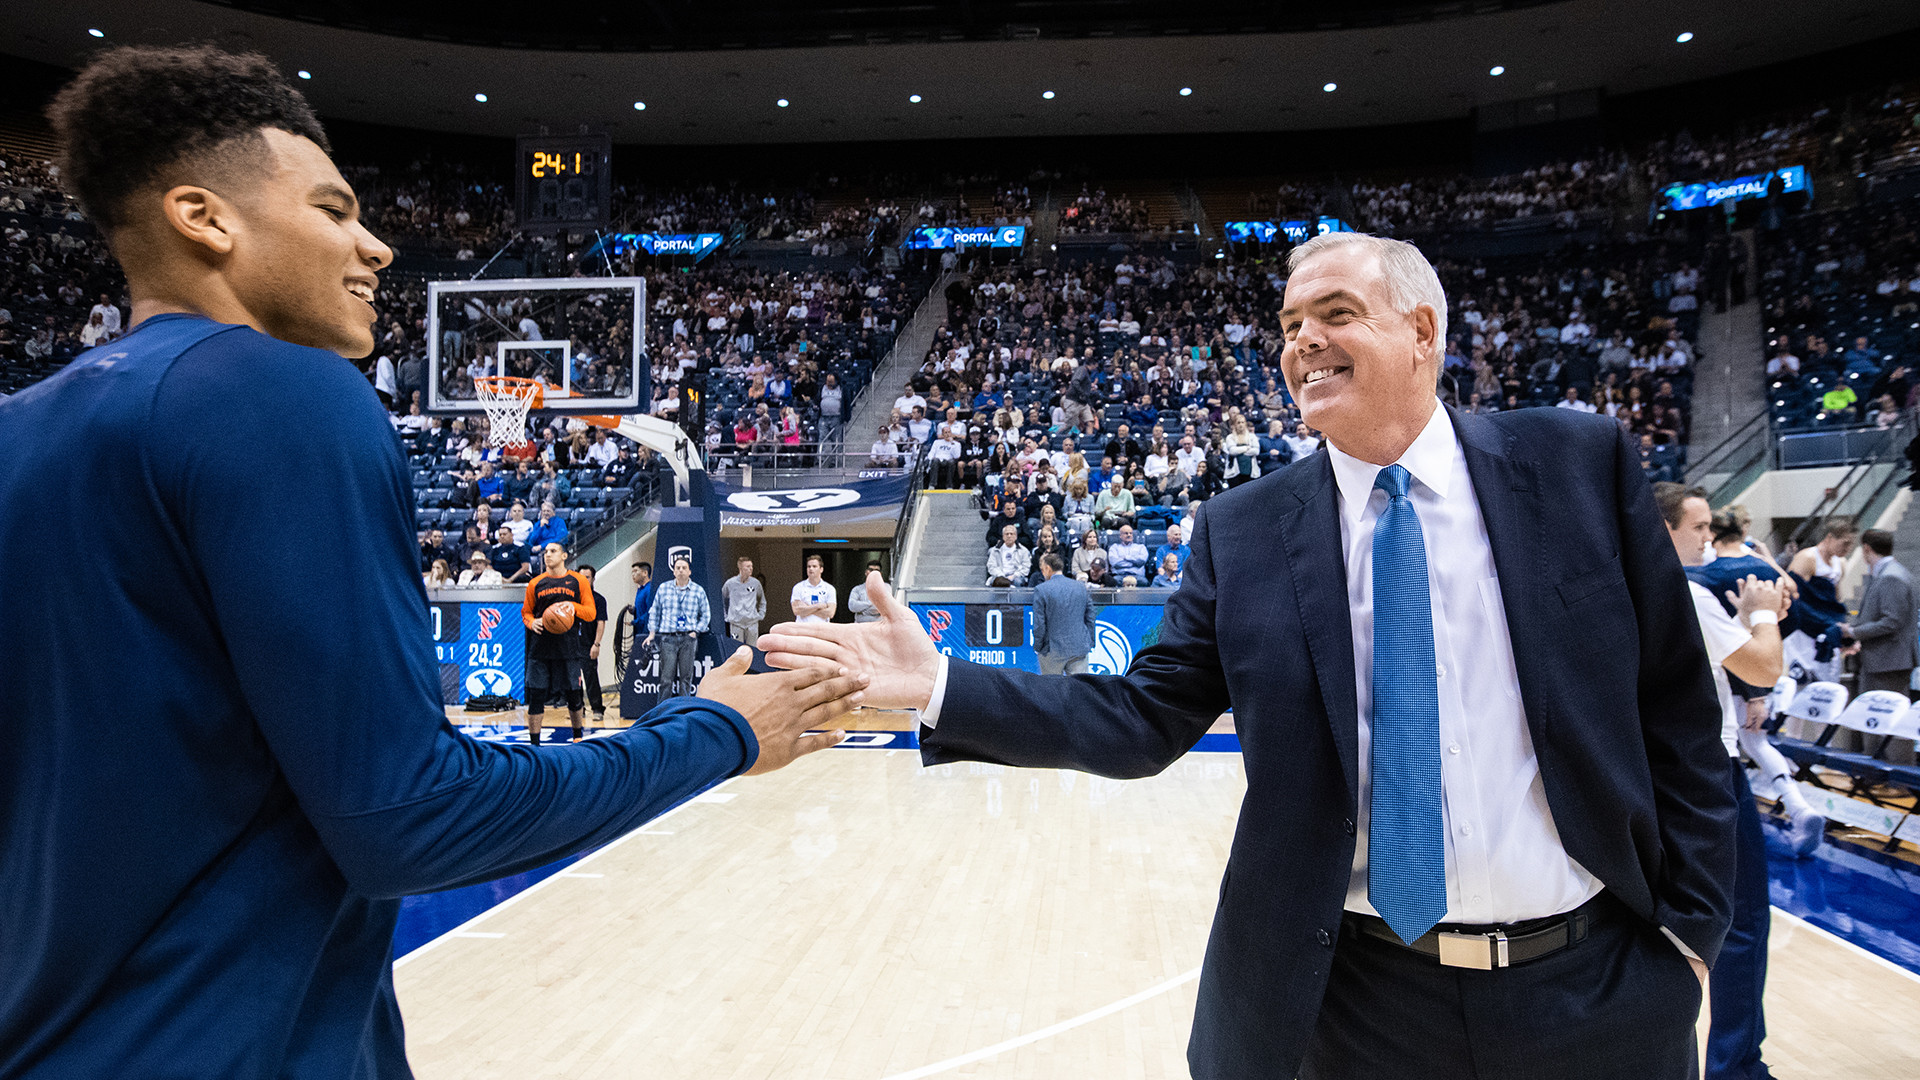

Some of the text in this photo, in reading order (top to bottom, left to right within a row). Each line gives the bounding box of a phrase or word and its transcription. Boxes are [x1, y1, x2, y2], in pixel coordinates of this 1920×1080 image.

[532, 151, 581, 178] 24.1
[1706, 180, 1765, 200] PORTAL
[953, 229, 1017, 244] PORTAL C
[653, 239, 696, 250] PORTAL
[858, 470, 886, 478] EXIT
[537, 586, 576, 599] PRINCETON
[986, 609, 1003, 645] 0
[468, 642, 503, 667] 24.2
[969, 650, 1005, 665] PERIOD
[1011, 650, 1017, 665] 1
